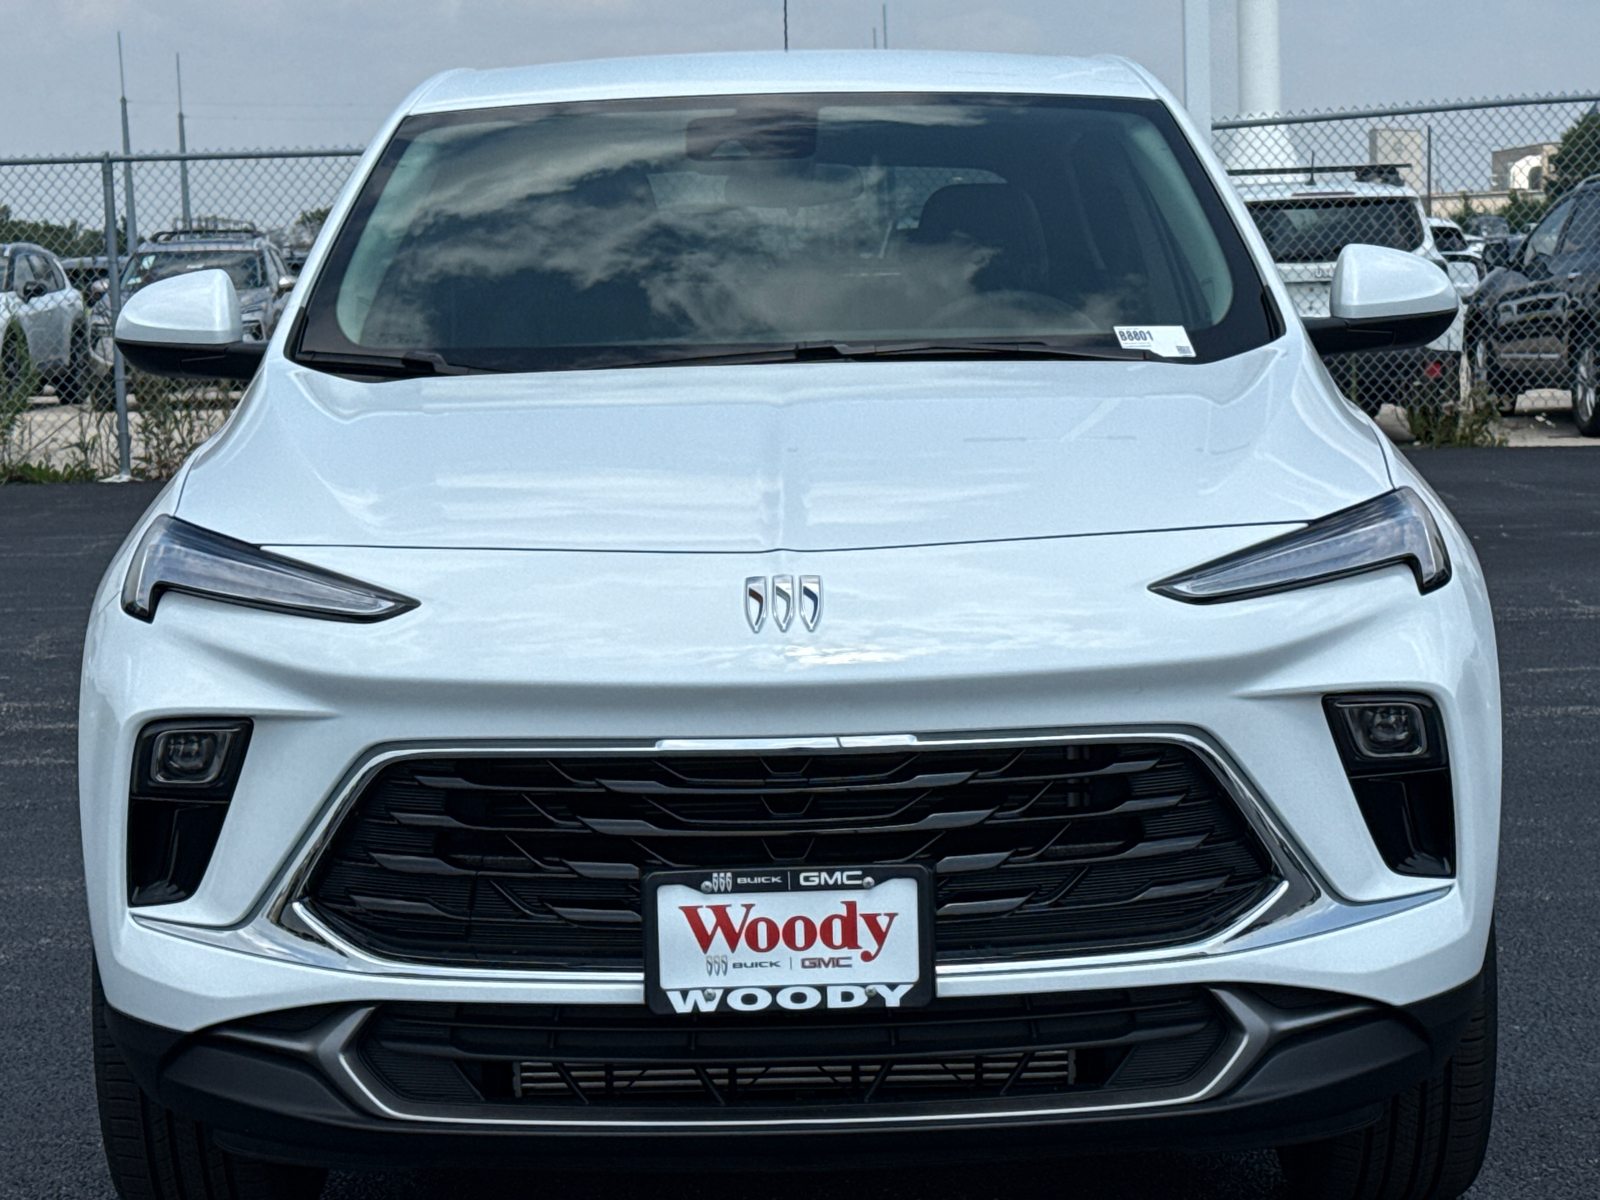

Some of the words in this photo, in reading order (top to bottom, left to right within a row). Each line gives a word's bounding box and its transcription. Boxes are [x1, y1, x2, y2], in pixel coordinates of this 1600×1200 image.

[1118, 330, 1154, 341] B8801
[737, 876, 782, 884] BUICK
[800, 871, 863, 886] GMC
[678, 901, 899, 962] Woody
[732, 960, 781, 968] BUICK
[801, 957, 852, 968] GMC
[666, 984, 914, 1013] WOODY
